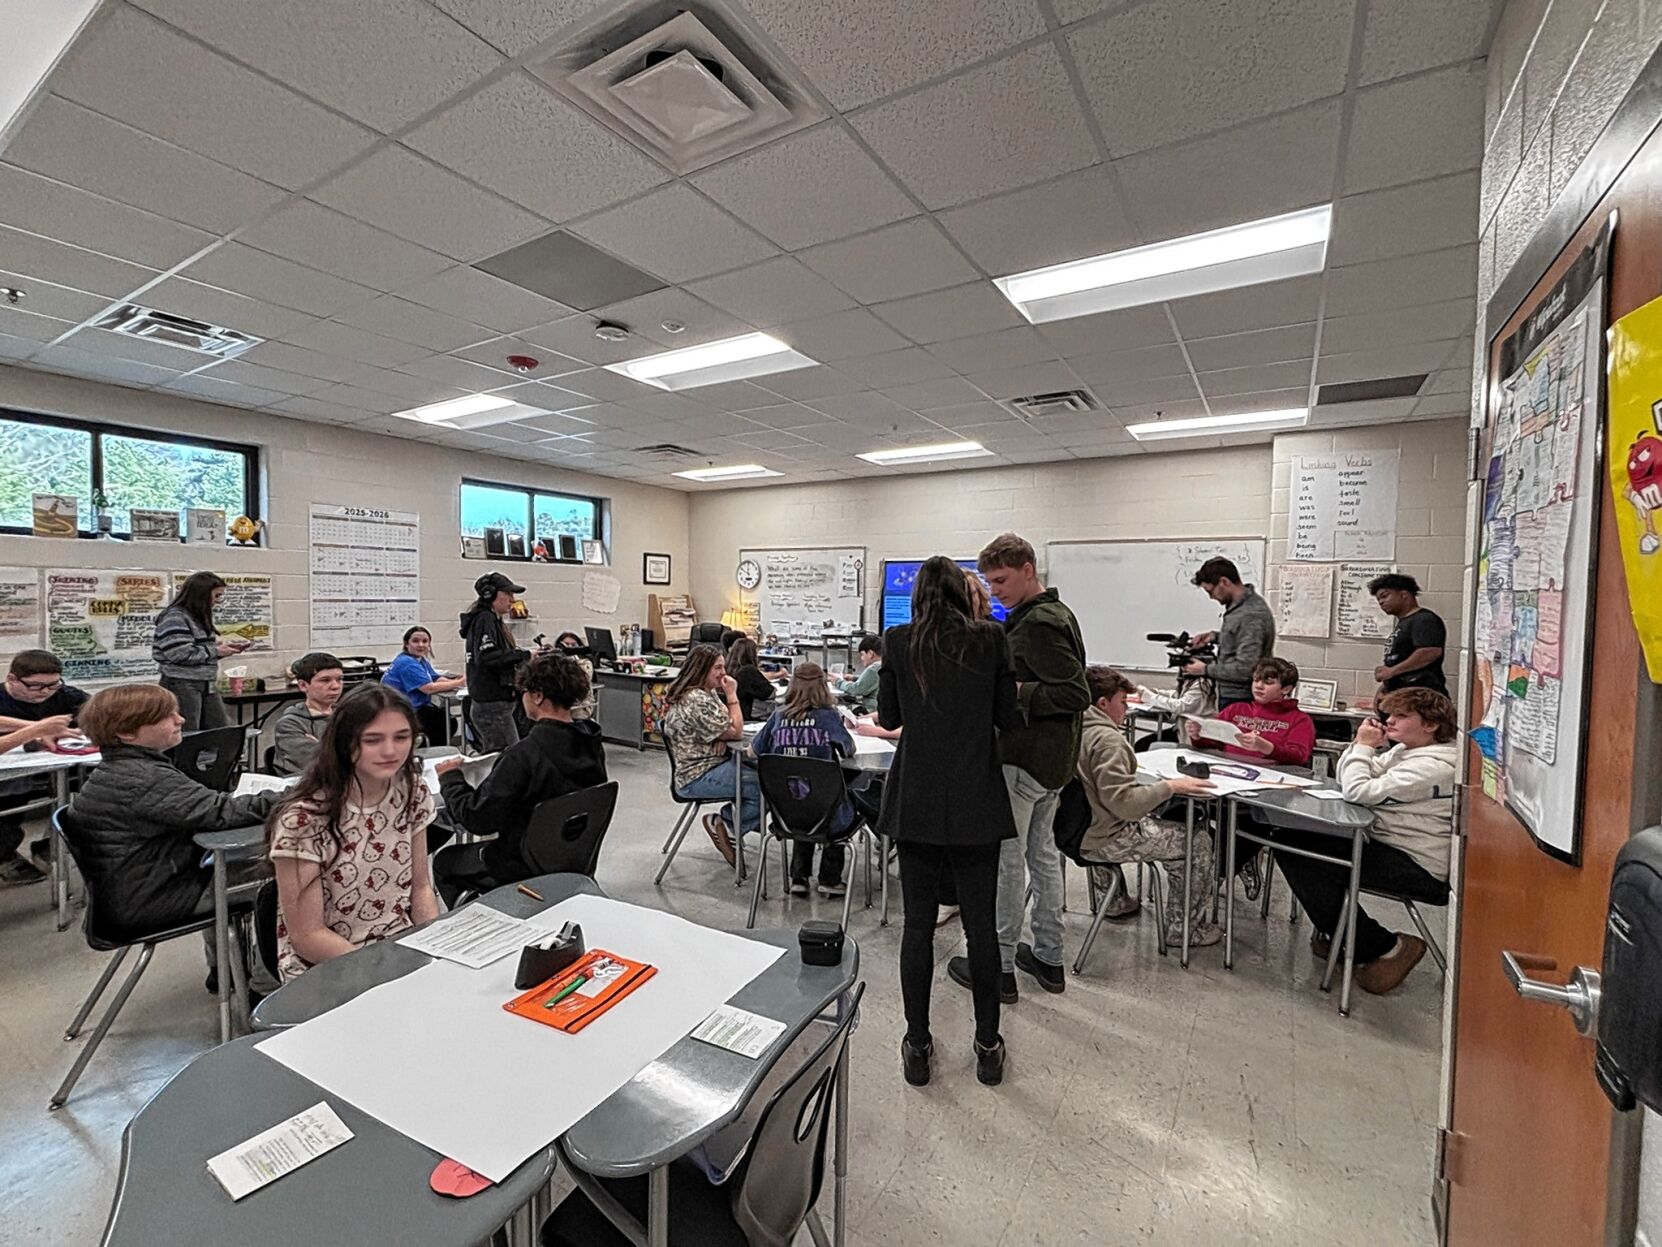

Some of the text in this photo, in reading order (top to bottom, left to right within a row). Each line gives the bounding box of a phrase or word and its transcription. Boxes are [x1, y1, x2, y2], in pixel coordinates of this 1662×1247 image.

[1345, 456, 1372, 466] Verbs
[1338, 470, 1364, 478] appear
[1339, 489, 1360, 497] taste
[1338, 498, 1360, 506] smell
[344, 507, 389, 519] 2025-2026
